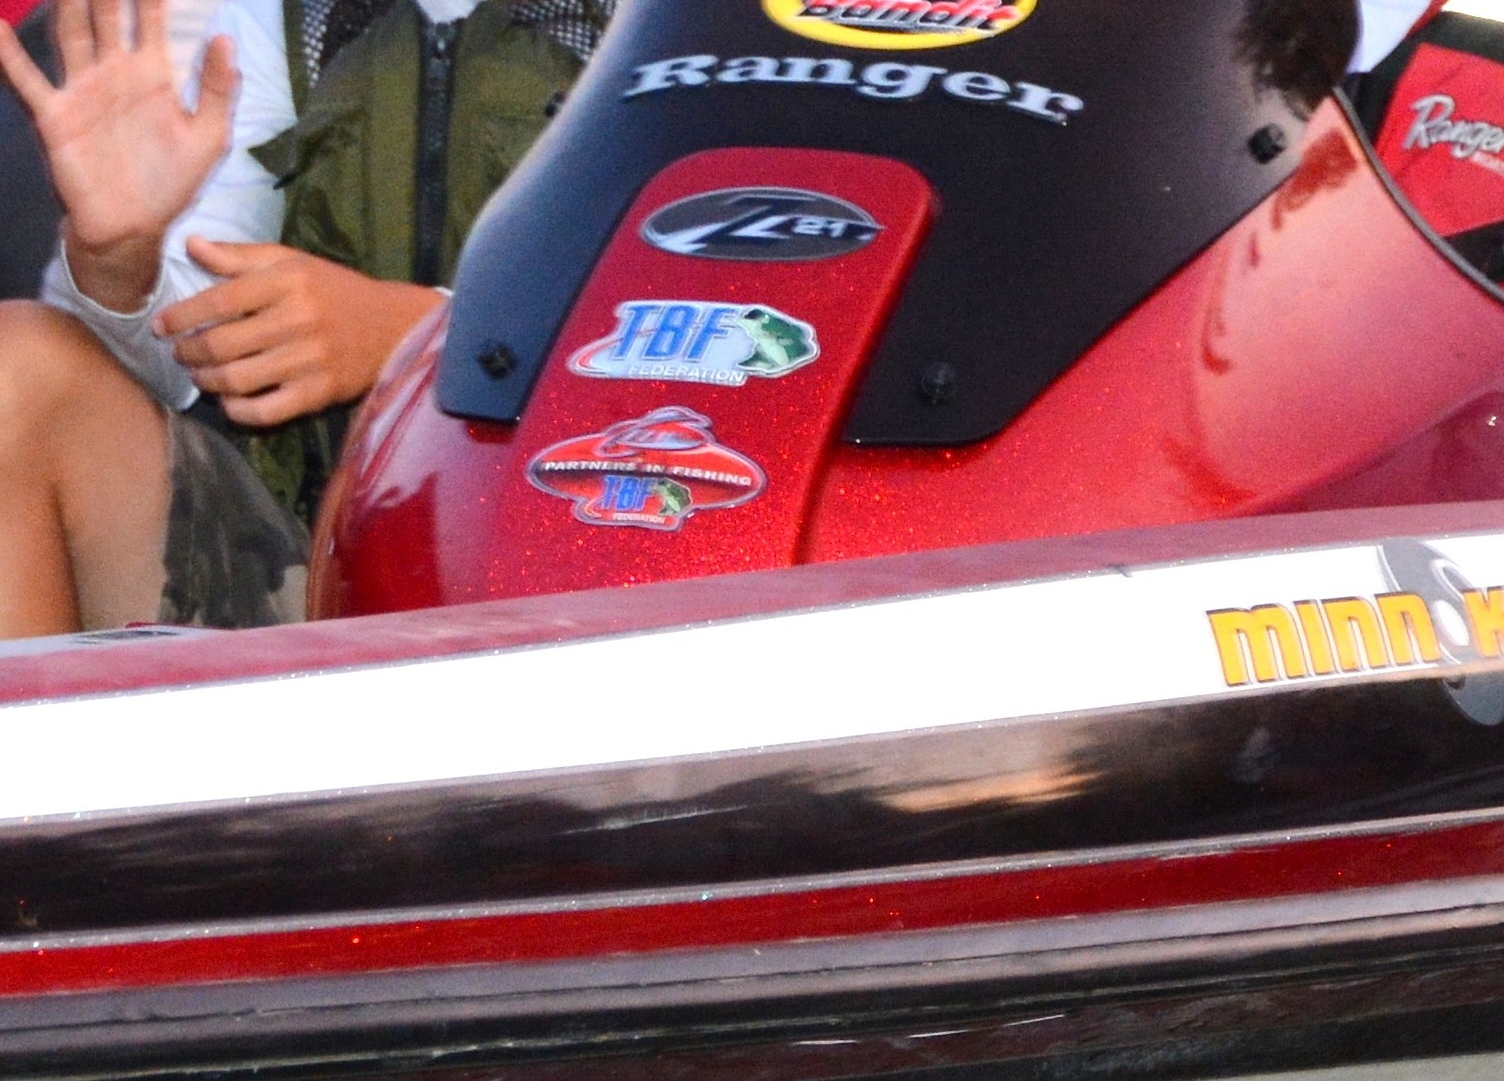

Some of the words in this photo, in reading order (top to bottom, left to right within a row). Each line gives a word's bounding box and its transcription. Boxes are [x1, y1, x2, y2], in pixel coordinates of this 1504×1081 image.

[622, 54, 1086, 126] Ranger
[612, 303, 743, 361] TBF
[628, 364, 746, 383] FEDERATION
[544, 461, 638, 472] PARTNERS
[645, 464, 666, 474] IN
[671, 465, 752, 487] FISHING
[602, 474, 660, 510] TBF
[1205, 591, 1442, 687] MINN
